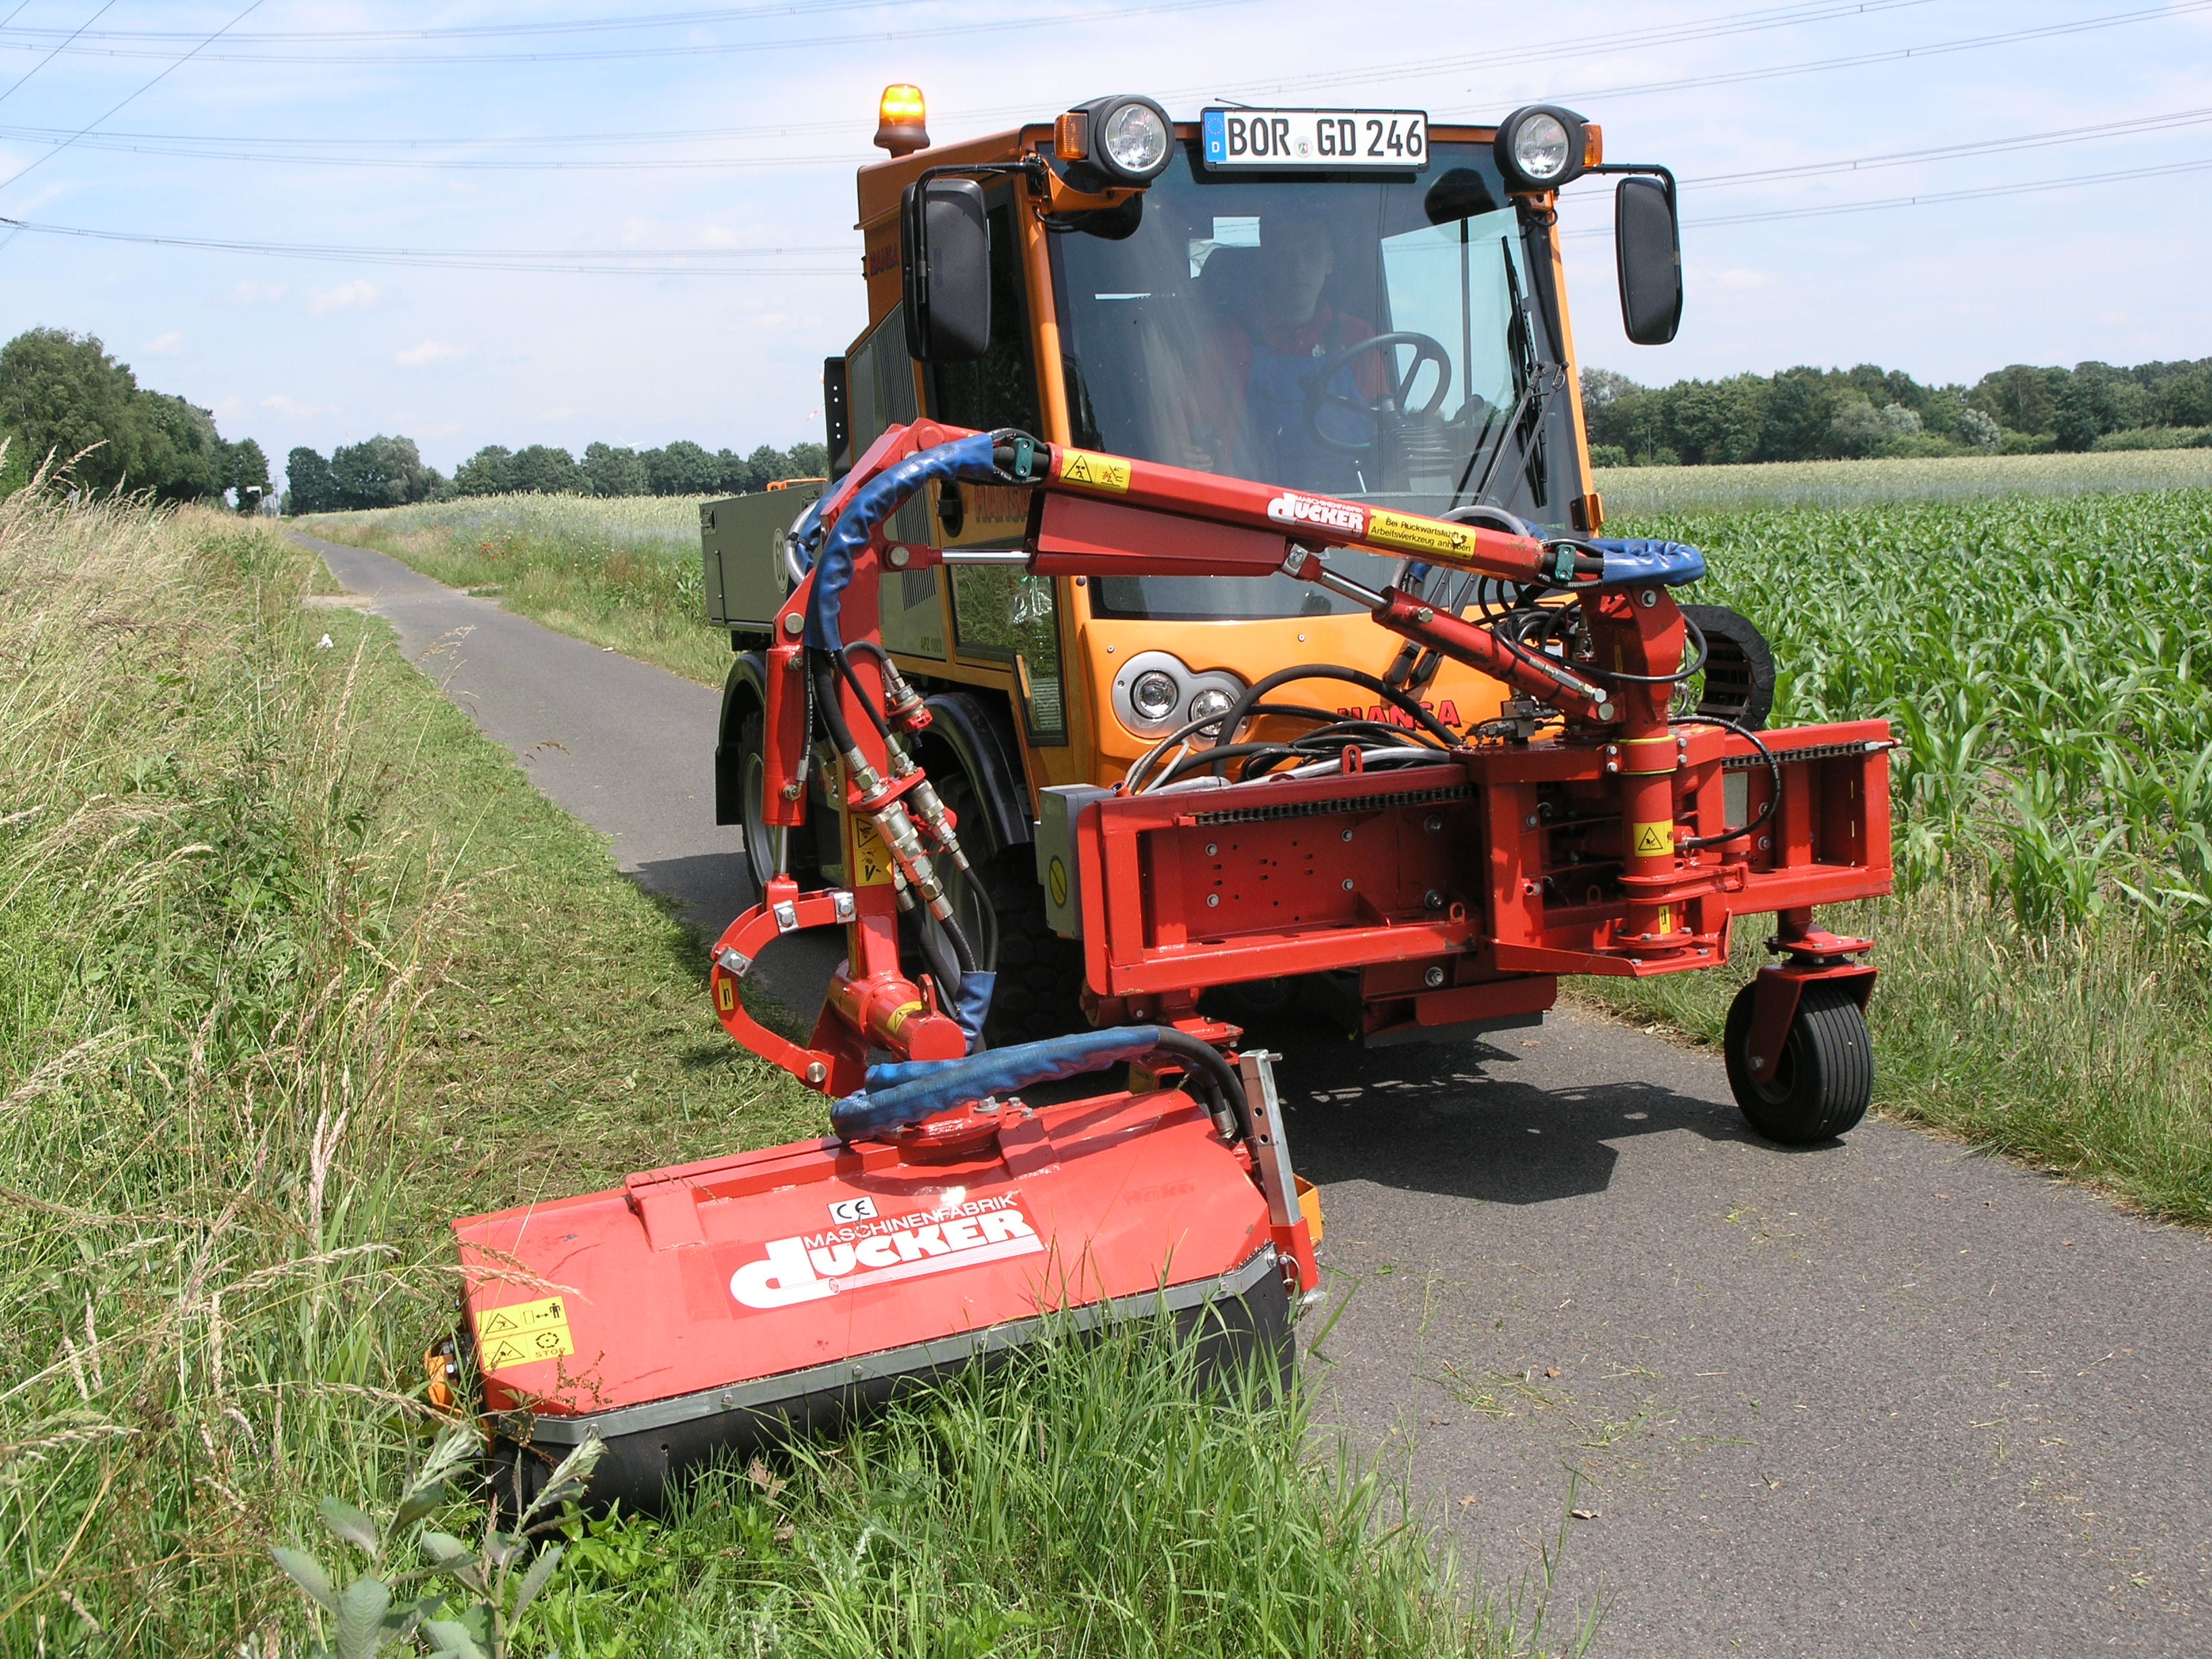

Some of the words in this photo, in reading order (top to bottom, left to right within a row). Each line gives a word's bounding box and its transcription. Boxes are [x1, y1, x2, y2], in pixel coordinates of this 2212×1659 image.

[1211, 141, 1220, 153] D
[1227, 117, 1291, 157] BOR
[1316, 119, 1357, 157] GD
[1365, 119, 1423, 157] 246
[1294, 494, 1364, 514] MASCHINENFABRIK
[1385, 517, 1398, 528] Bei
[1370, 526, 1435, 547] Arbeitswerkzeug
[1437, 538, 1471, 552] anhben
[775, 540, 786, 581] 60
[804, 1192, 1019, 1250] MASCHINENFABRIK
[535, 1347, 566, 1358] STOP
